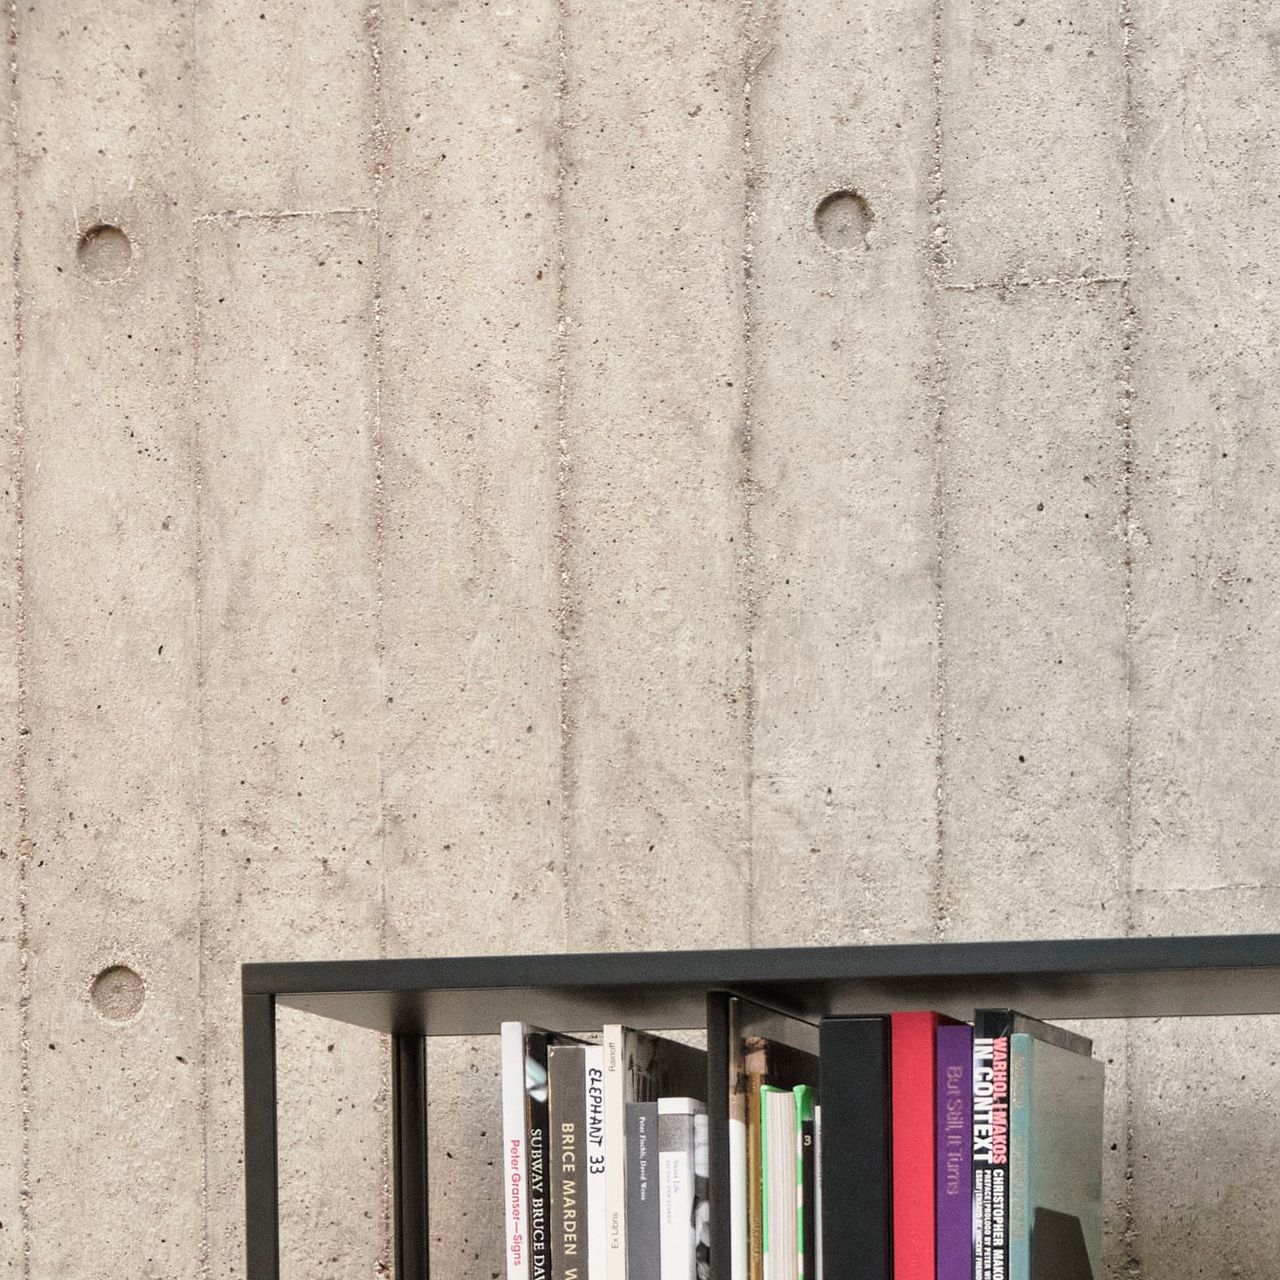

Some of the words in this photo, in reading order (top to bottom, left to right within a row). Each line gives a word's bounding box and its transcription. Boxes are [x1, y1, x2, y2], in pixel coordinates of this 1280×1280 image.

[974, 1038, 993, 1059] IN
[947, 1066, 963, 1095] But
[993, 1037, 1007, 1100] WARHOL
[588, 1068, 604, 1147] ELEPHANT
[945, 1098, 964, 1131] Still,
[974, 1067, 993, 1164] CONTEXT
[638, 1116, 647, 1133] Peter
[804, 1135, 812, 1146] 3
[948, 1135, 963, 1147] It
[993, 1111, 1007, 1164] MAKOS
[510, 1139, 520, 1170] Peter
[531, 1128, 544, 1193] SUBWAY
[561, 1122, 576, 1172] BRICE
[589, 1154, 605, 1175] 33
[639, 1160, 648, 1181] David
[948, 1149, 963, 1195] Turns
[563, 1179, 577, 1255] MARDEN
[993, 1169, 1004, 1246] CHRISTOPHER
[532, 1198, 545, 1251] BRUCE
[984, 1236, 992, 1246] BY
[984, 1247, 992, 1269] PETER
